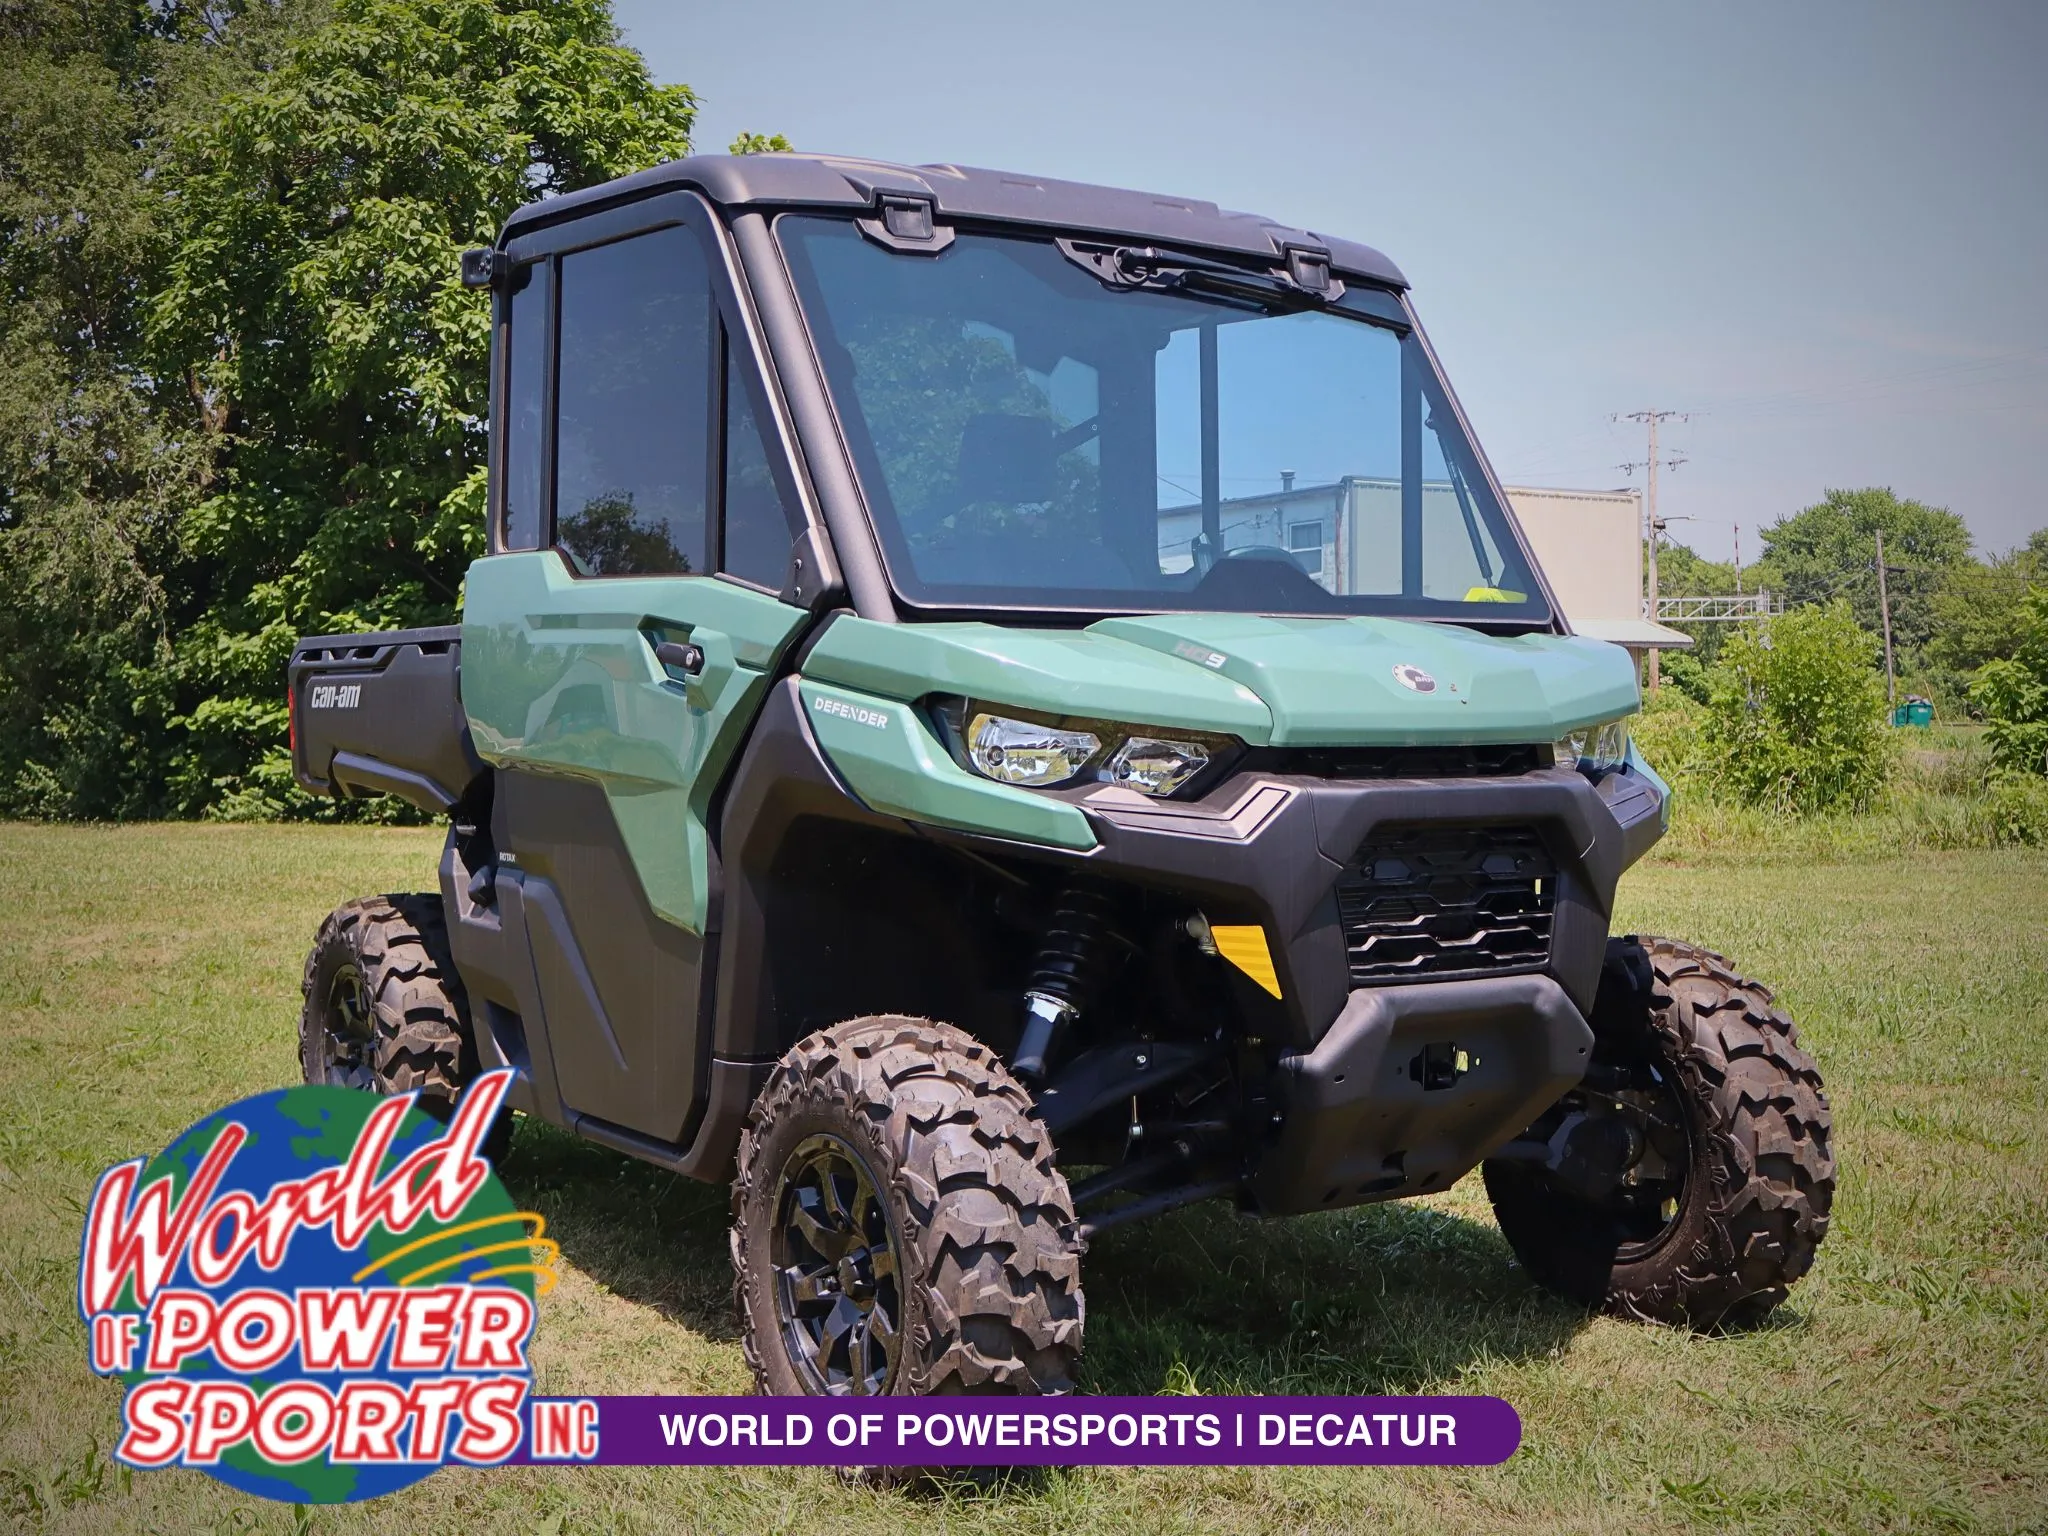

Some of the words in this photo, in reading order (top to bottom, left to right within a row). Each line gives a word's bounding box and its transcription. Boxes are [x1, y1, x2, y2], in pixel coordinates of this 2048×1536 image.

[311, 684, 361, 708] can-am
[814, 697, 889, 729] DEFENDER
[499, 851, 516, 863] ROTAX
